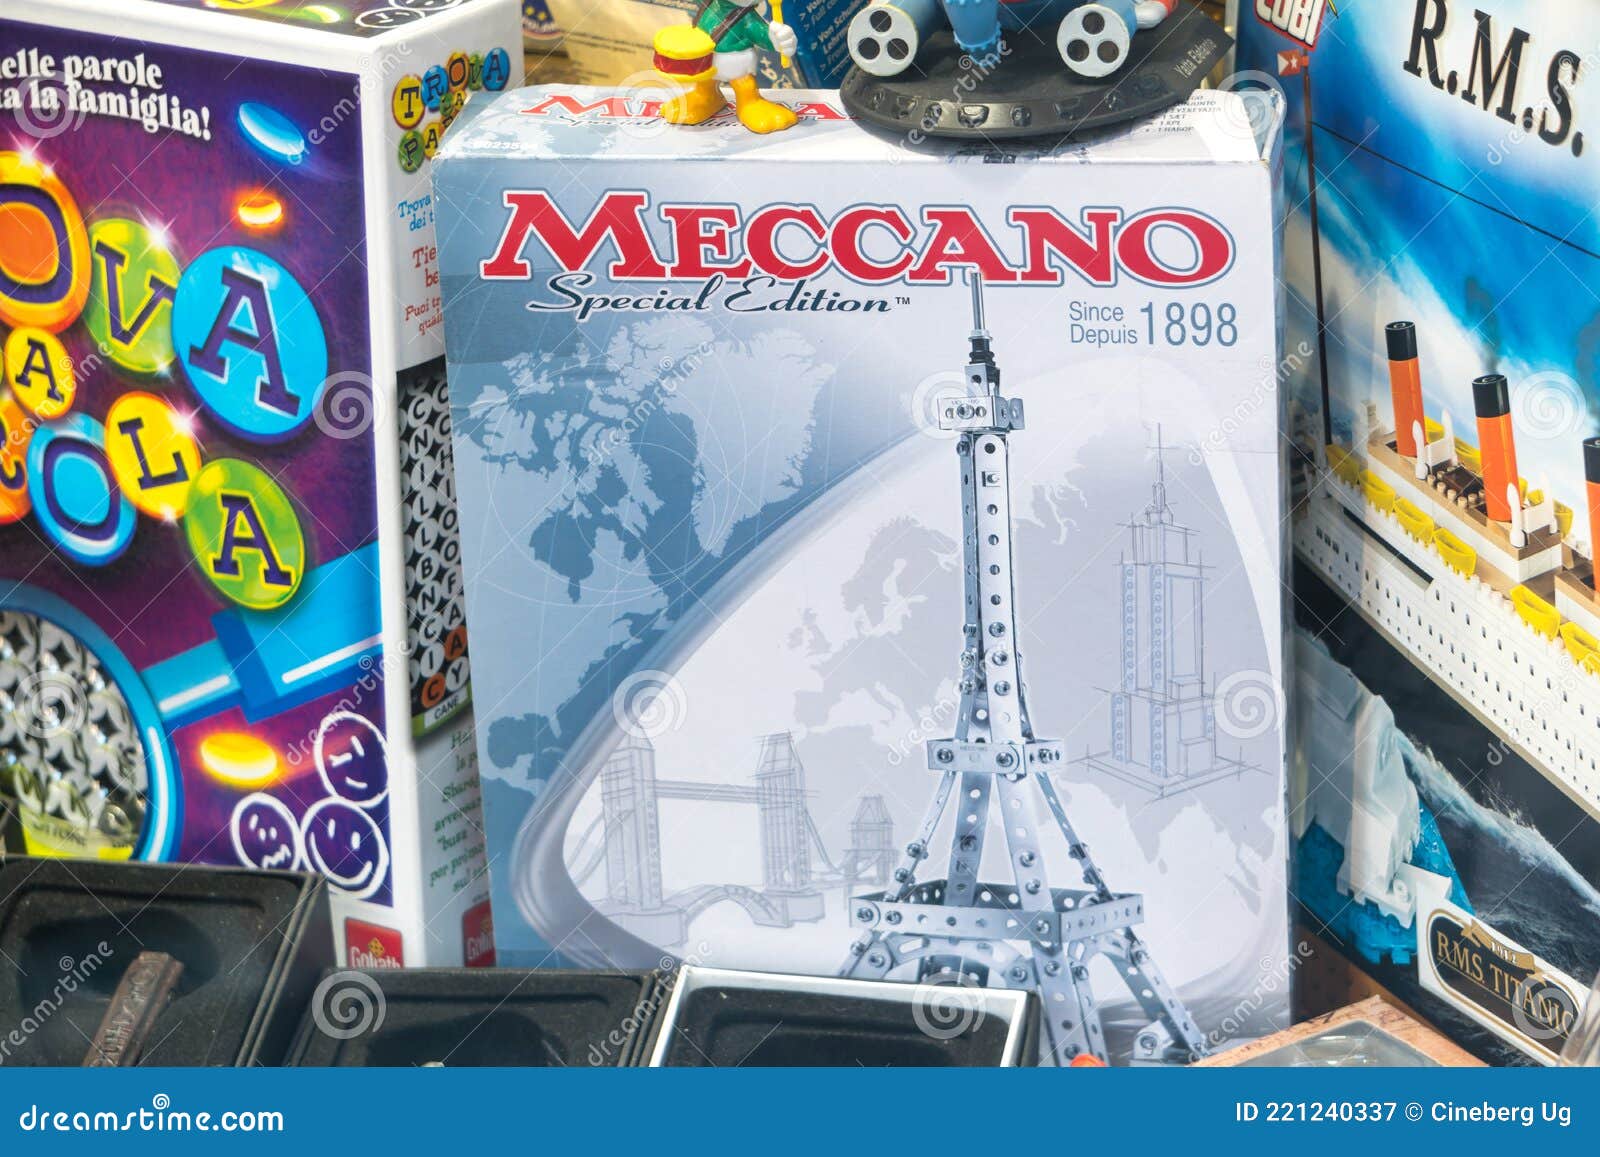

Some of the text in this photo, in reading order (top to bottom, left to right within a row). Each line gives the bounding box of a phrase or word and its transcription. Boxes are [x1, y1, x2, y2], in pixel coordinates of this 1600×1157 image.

[0, 48, 163, 89] elle parole
[29, 80, 60, 110] la
[67, 81, 212, 142] famiglia!
[480, 188, 1235, 288] MECCANO
[528, 273, 724, 321] Special
[724, 275, 892, 313] Edition
[1069, 301, 1124, 321] Since
[1070, 324, 1138, 348] Depuis
[1140, 301, 1238, 347] 1898
[1490, 963, 1575, 1038] TITANIC
